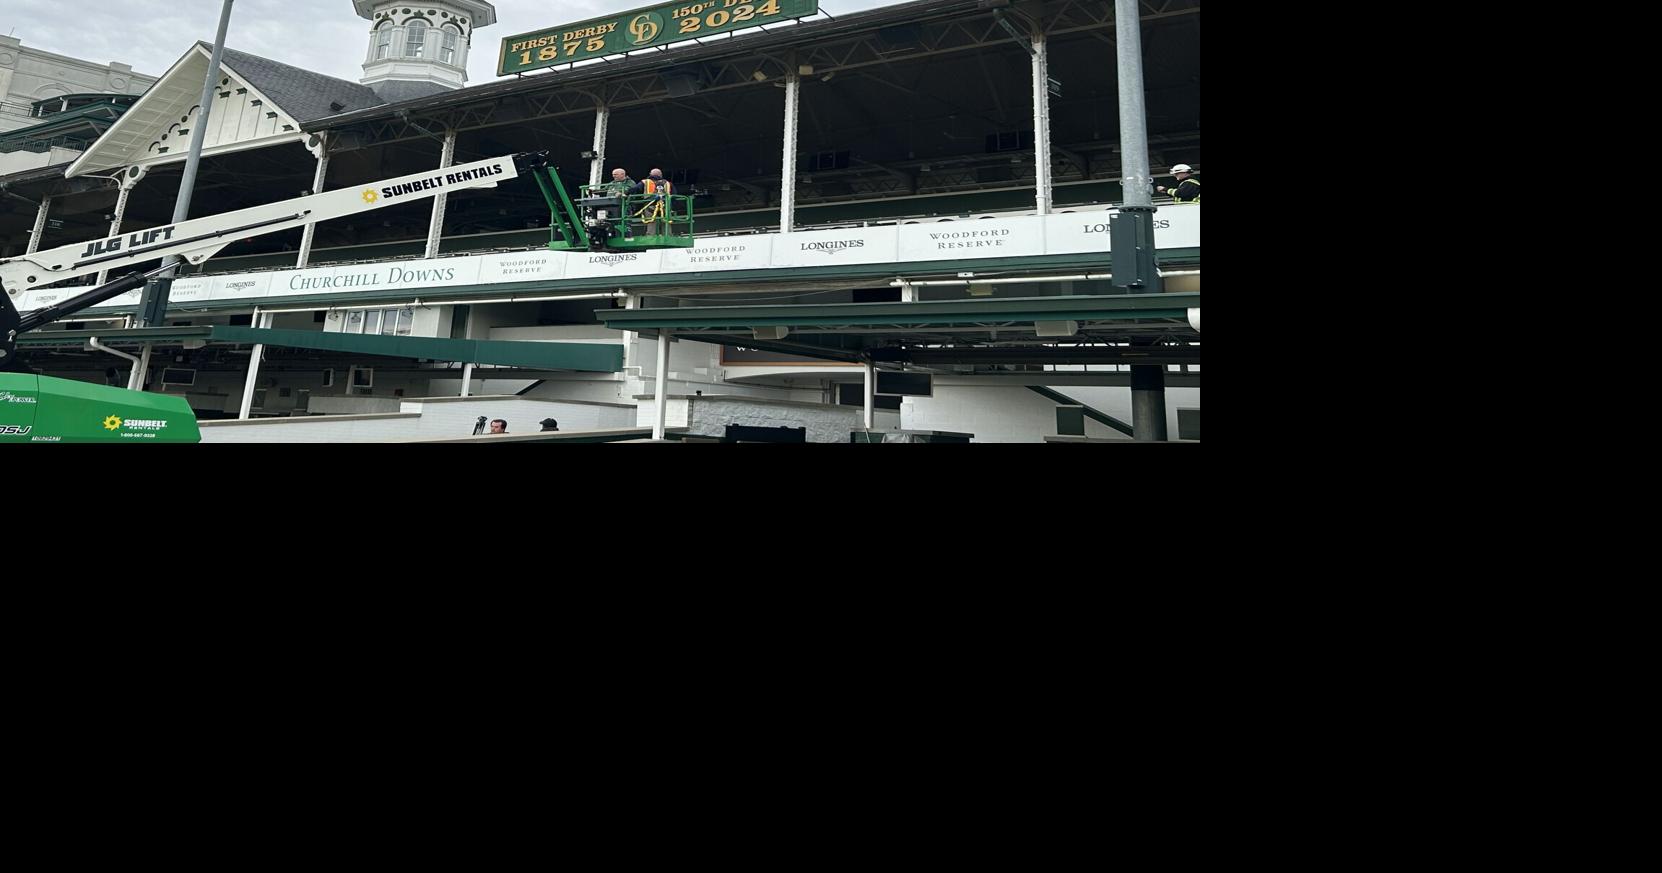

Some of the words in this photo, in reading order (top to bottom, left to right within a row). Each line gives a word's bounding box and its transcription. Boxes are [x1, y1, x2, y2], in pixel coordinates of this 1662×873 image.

[679, 0, 781, 34] 2024
[511, 34, 558, 53] FIRST
[562, 22, 618, 42] DERBY
[519, 35, 605, 65] 1875
[381, 176, 443, 199] SUNBELT
[446, 164, 503, 185] RENTALS
[1083, 219, 1170, 234] LOES
[930, 228, 1010, 240] WOODFORD
[81, 236, 122, 258] JLG
[129, 226, 175, 247] LIFT
[801, 239, 864, 251] LONGINES
[937, 239, 1003, 249] RESERVE
[685, 245, 746, 255] WOODFORD
[500, 258, 547, 267] WOODFORD
[589, 253, 637, 264] LONGINES
[690, 254, 740, 263] RESERVE
[502, 266, 542, 275] RESERVE
[289, 274, 380, 290] CHURCHILL
[388, 267, 455, 284] DOWNS
[225, 281, 256, 289] LONGINES
[124, 419, 167, 428] SUNBELT
